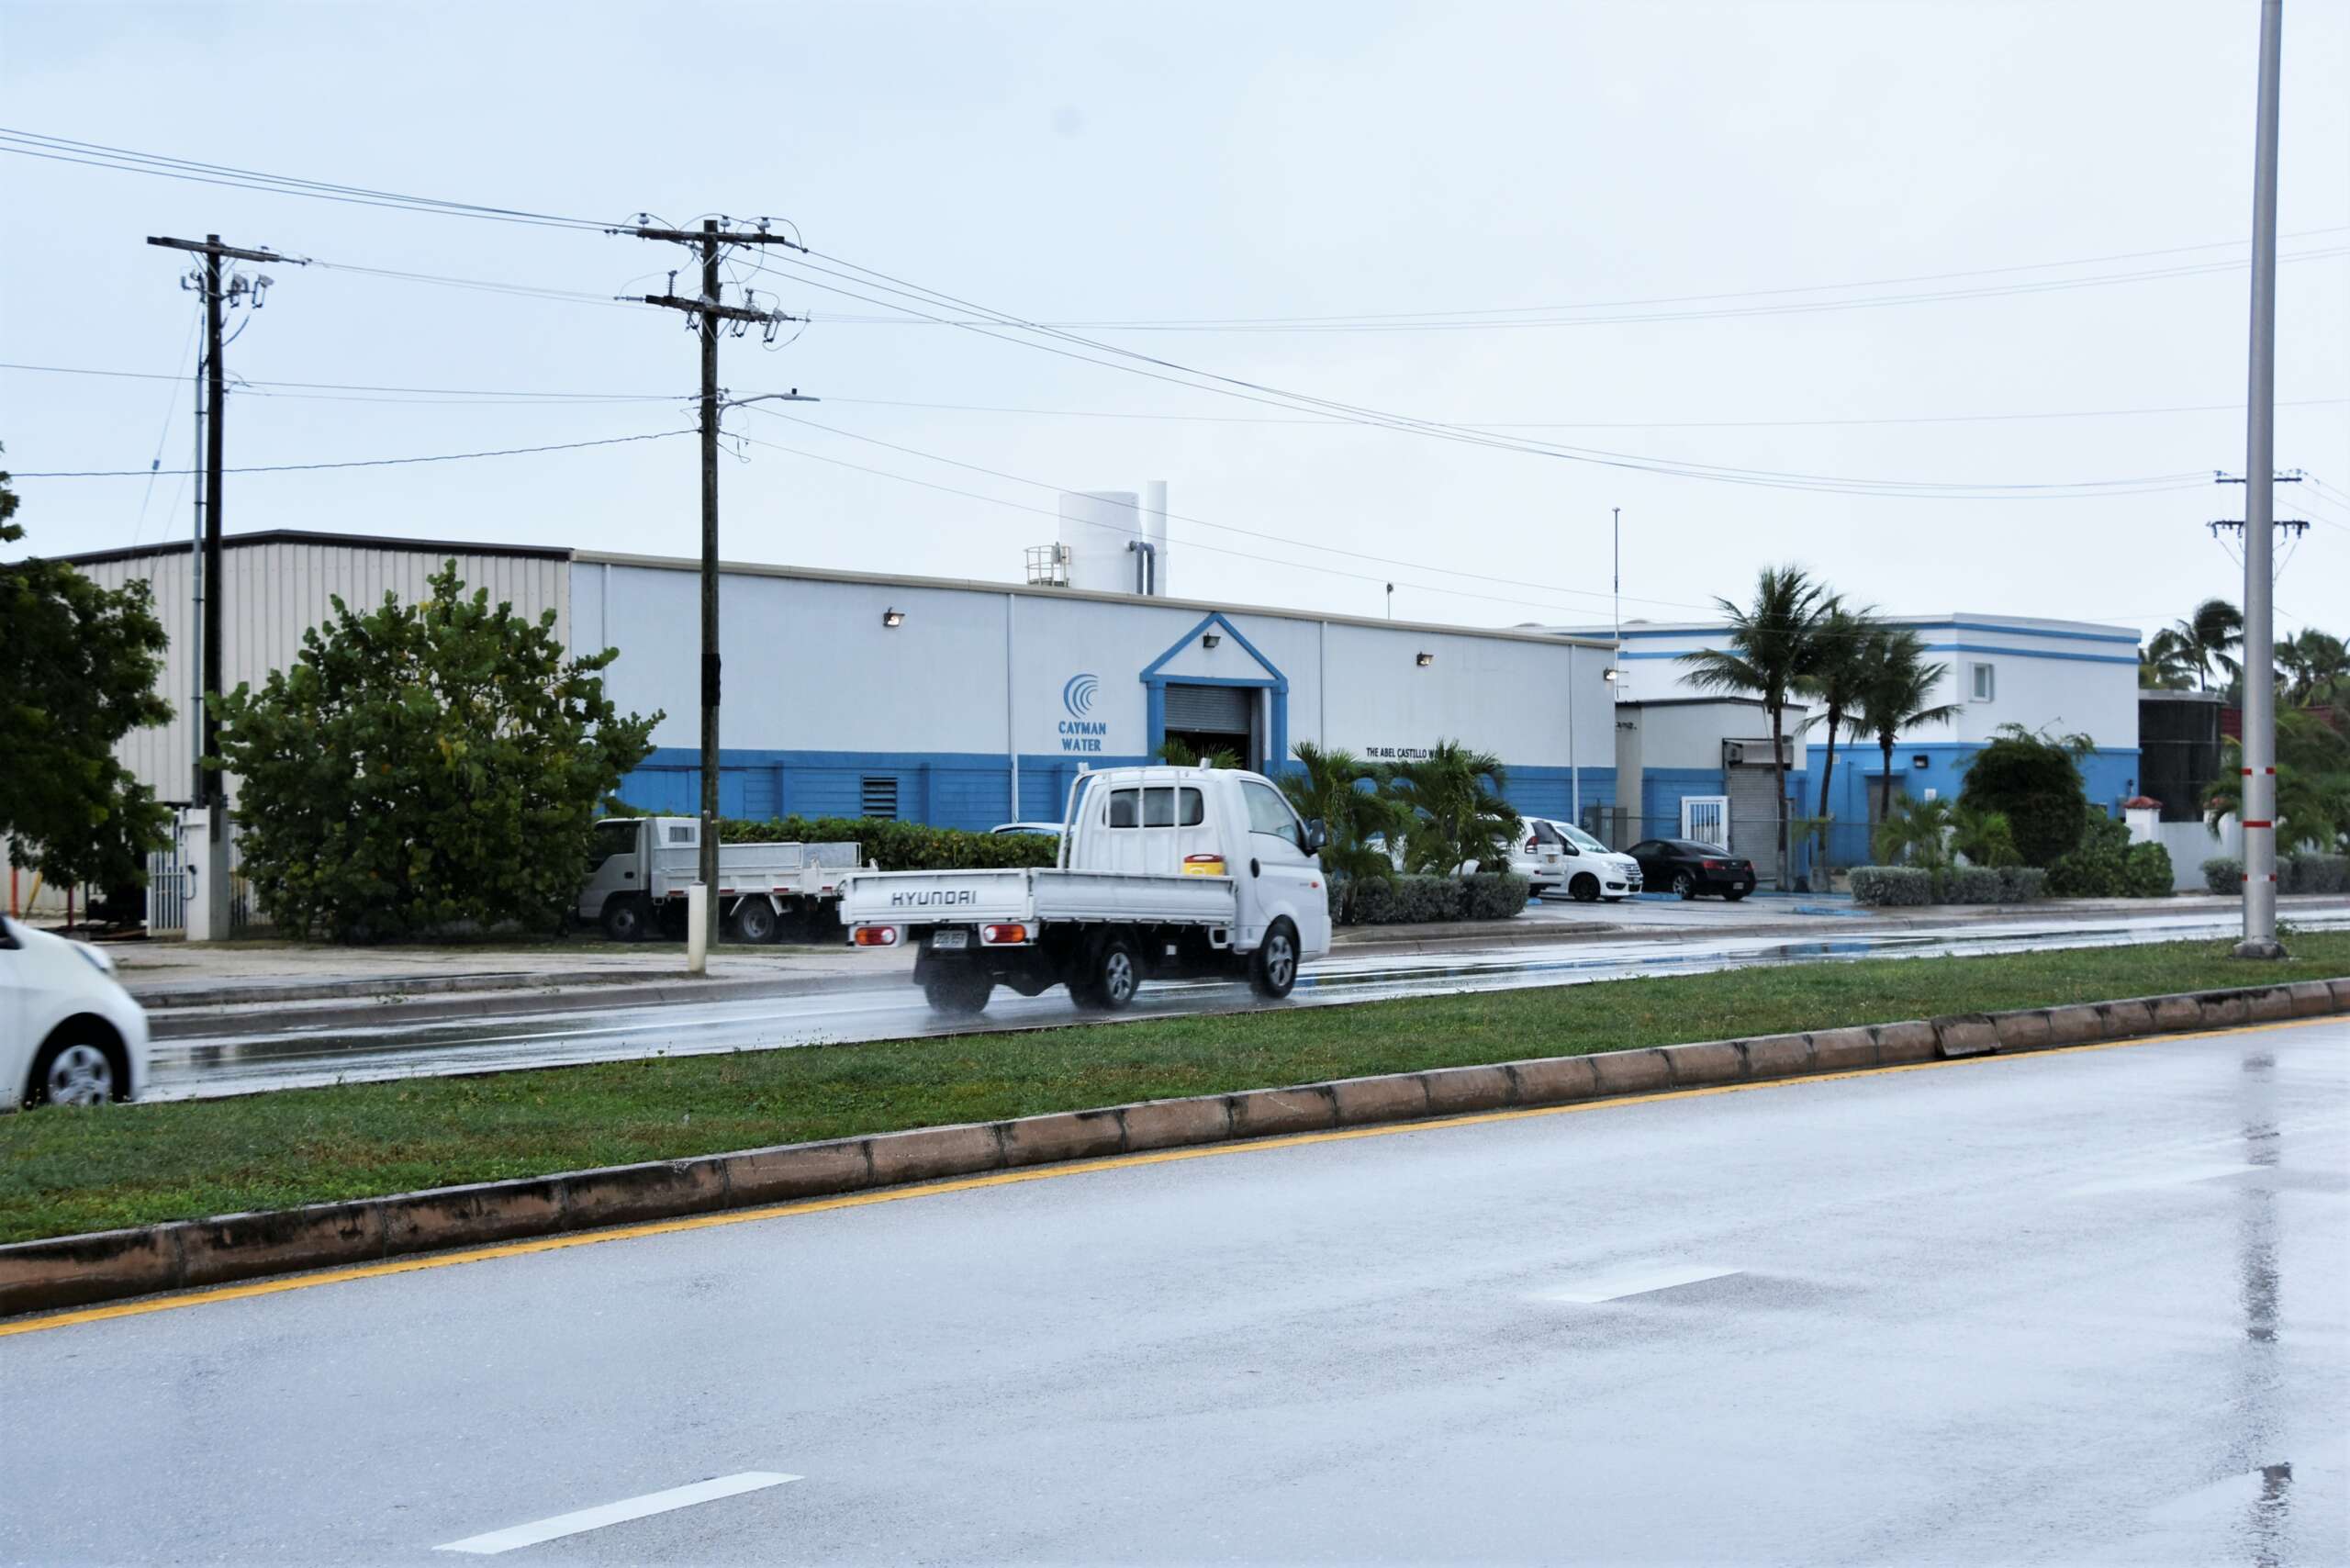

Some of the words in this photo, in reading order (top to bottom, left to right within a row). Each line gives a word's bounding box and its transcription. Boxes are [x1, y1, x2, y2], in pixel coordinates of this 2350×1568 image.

[1058, 721, 1106, 735] CAYMAN
[1061, 738, 1102, 752] WATER
[1366, 747, 1378, 757] THE
[1380, 747, 1395, 757] ABEL
[1397, 748, 1427, 758] CASTILLO
[891, 890, 977, 906] HYUNDAI
